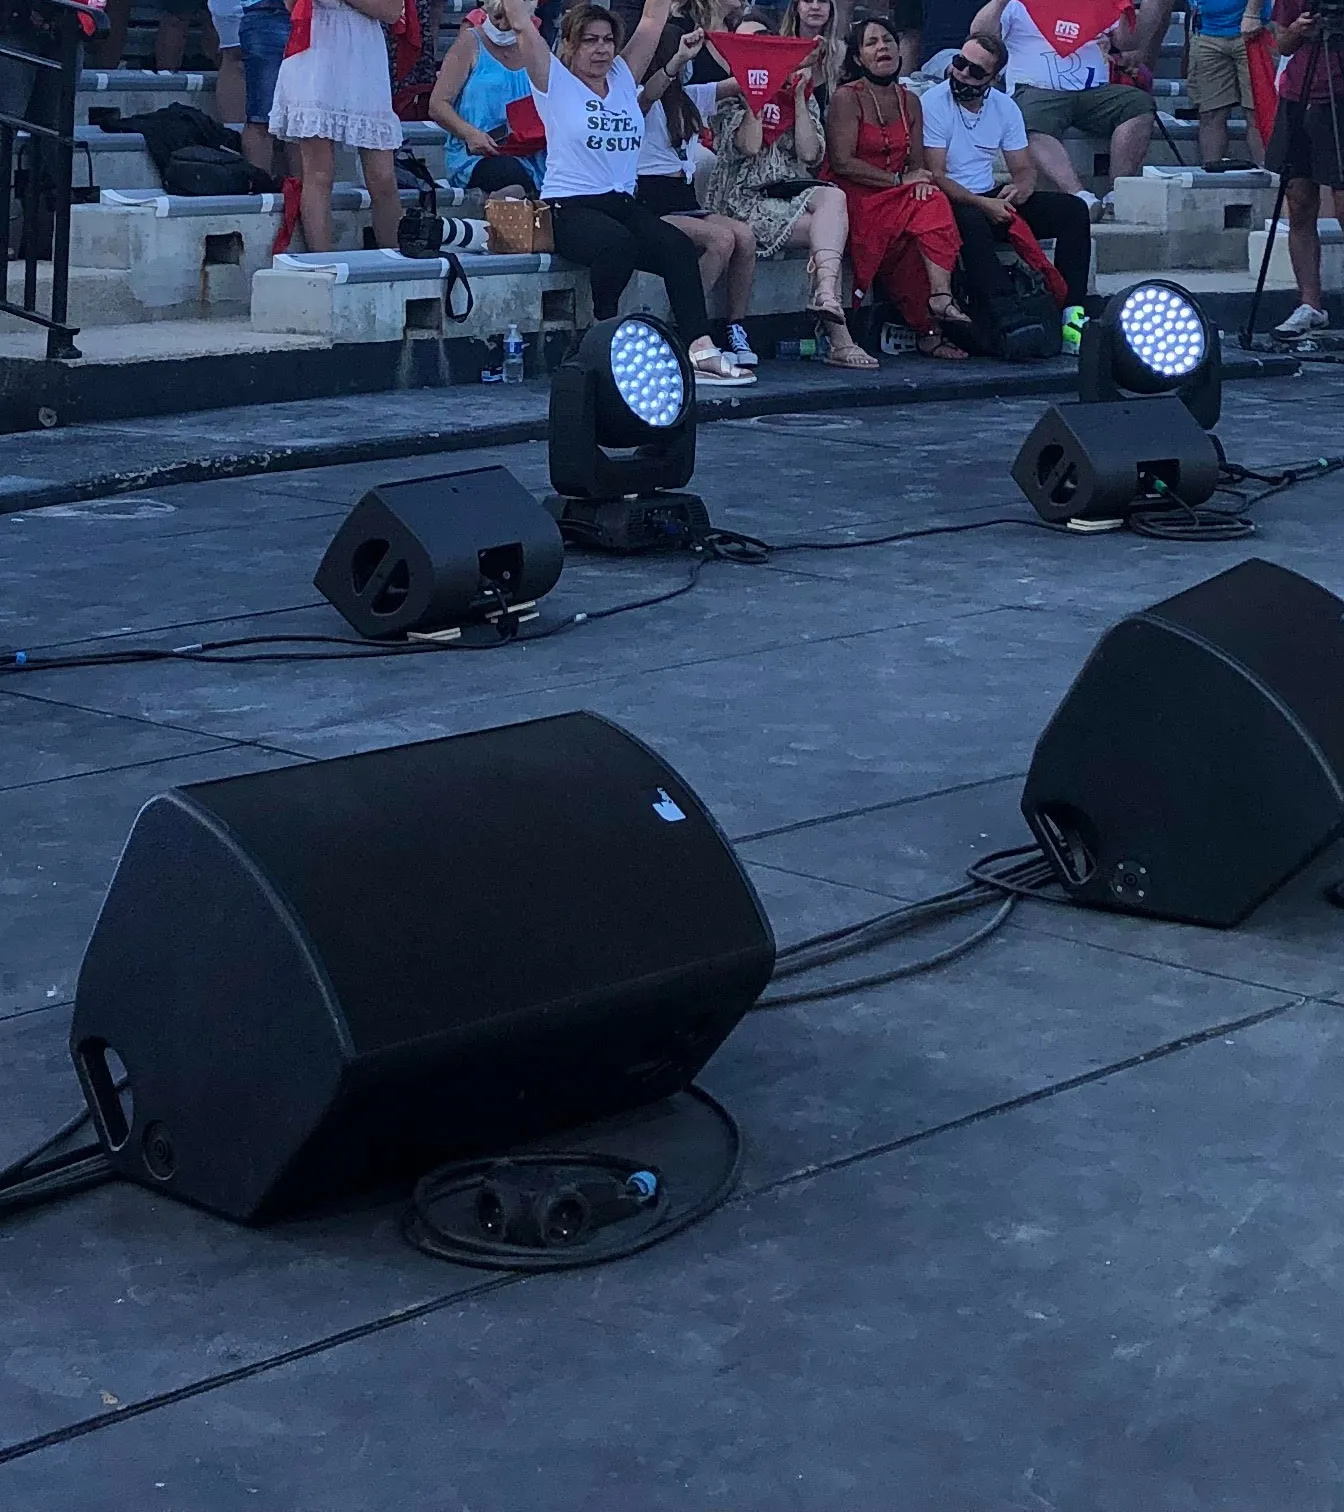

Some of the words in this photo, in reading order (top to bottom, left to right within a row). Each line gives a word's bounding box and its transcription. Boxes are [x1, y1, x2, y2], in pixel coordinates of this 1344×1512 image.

[1056, 20, 1080, 36] RTS
[748, 69, 769, 85] RTS
[586, 135, 604, 150] &
[606, 136, 642, 152] SUN
